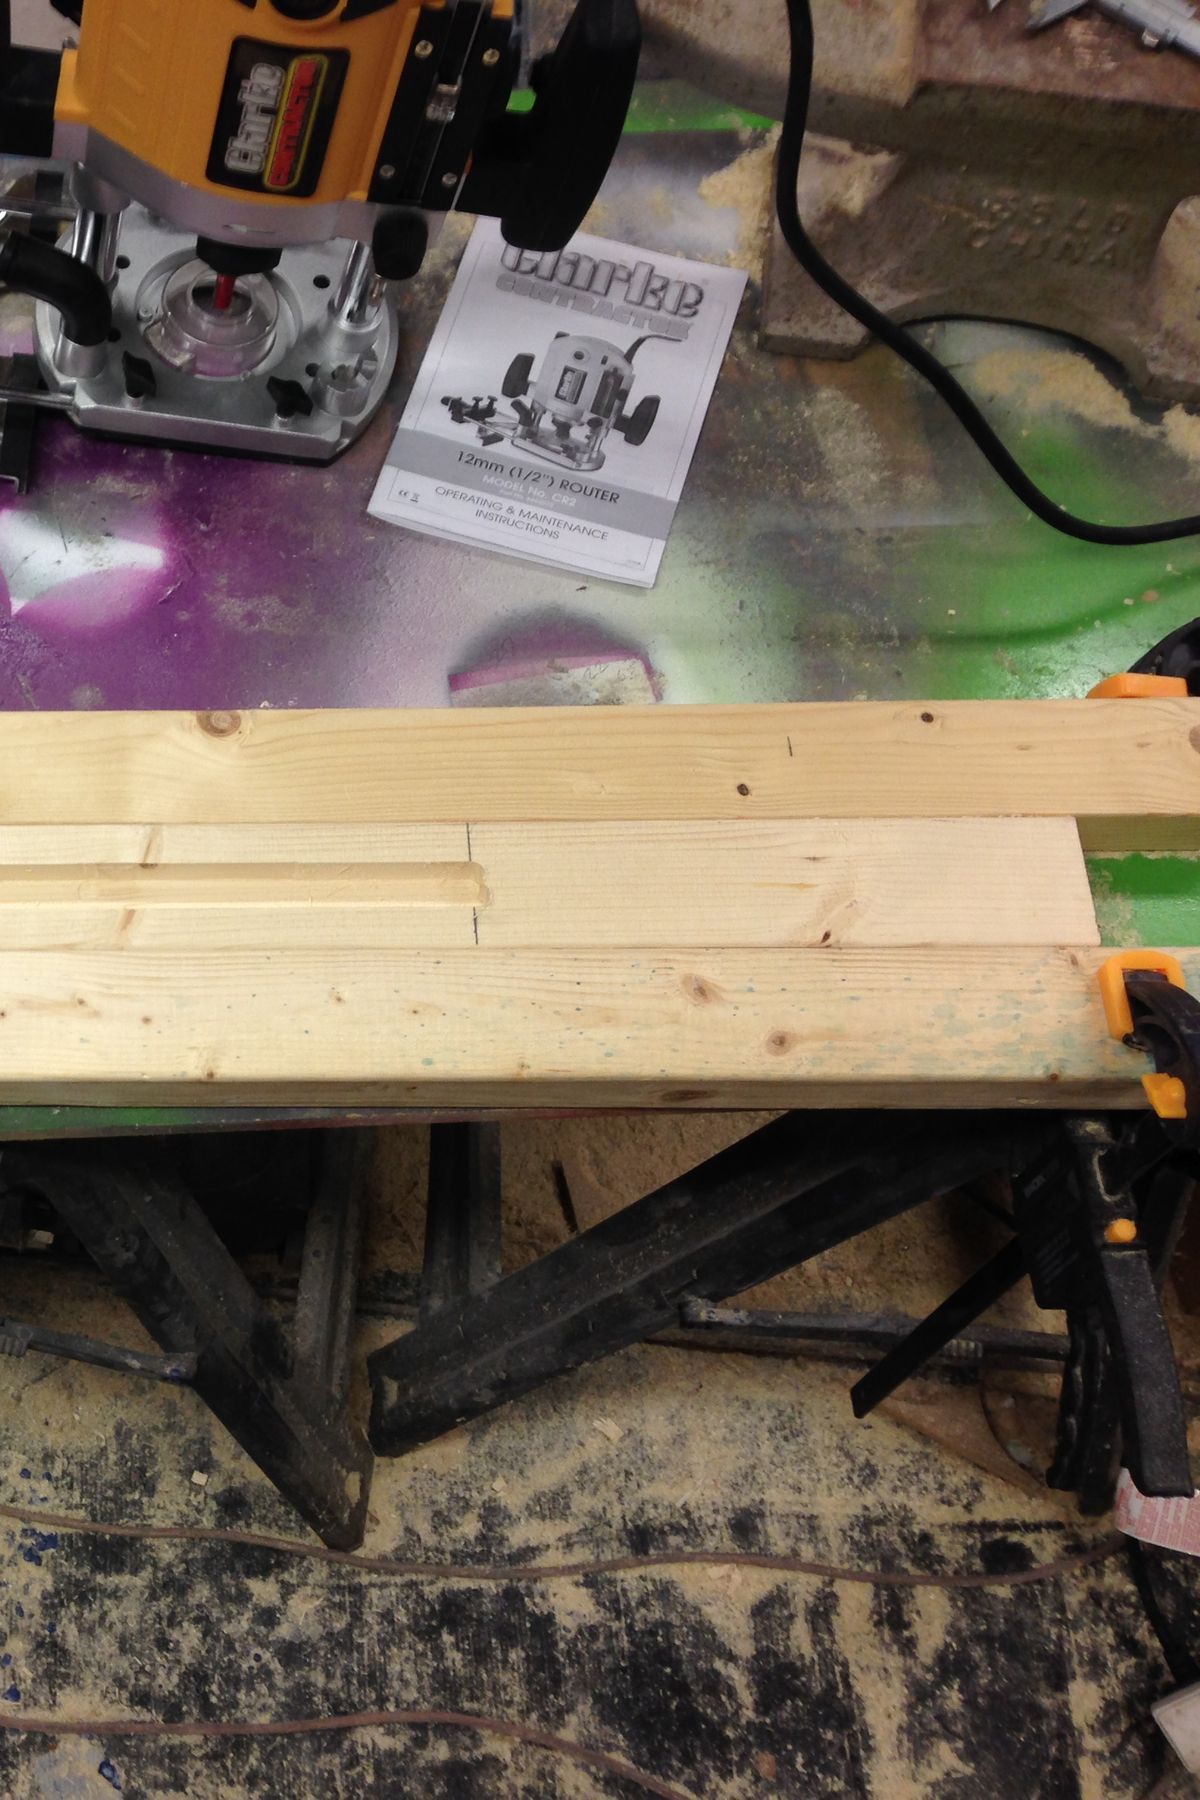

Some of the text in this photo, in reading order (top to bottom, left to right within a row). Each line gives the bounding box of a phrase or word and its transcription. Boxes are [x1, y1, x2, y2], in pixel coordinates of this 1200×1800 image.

[224, 63, 285, 173] Clarke
[496, 273, 693, 340] CONTRACTOR
[457, 450, 504, 474] 12mm
[559, 478, 620, 503] ROUTER
[482, 474, 525, 494] MODEL
[550, 492, 577, 508] CR2
[435, 485, 502, 512] OPERATING
[506, 505, 515, 516] &
[519, 508, 609, 541] MAINTENANCE
[475, 509, 560, 540] INSTRUCTIONS
